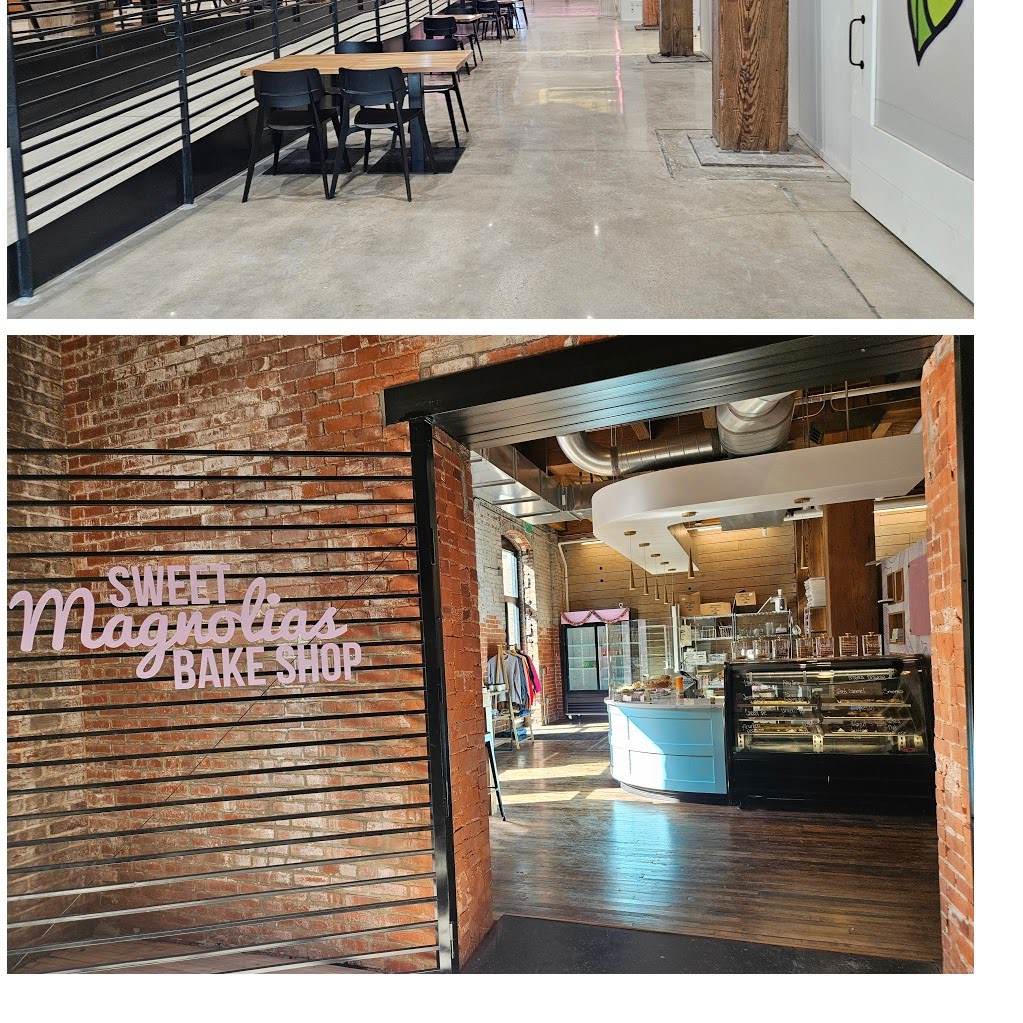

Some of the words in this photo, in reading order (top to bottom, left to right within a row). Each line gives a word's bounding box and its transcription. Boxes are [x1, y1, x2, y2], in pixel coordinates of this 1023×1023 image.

[108, 564, 231, 607] SWEET
[9, 576, 348, 679] Magnolias
[173, 646, 267, 690] BAKE
[276, 642, 362, 685] SHOP
